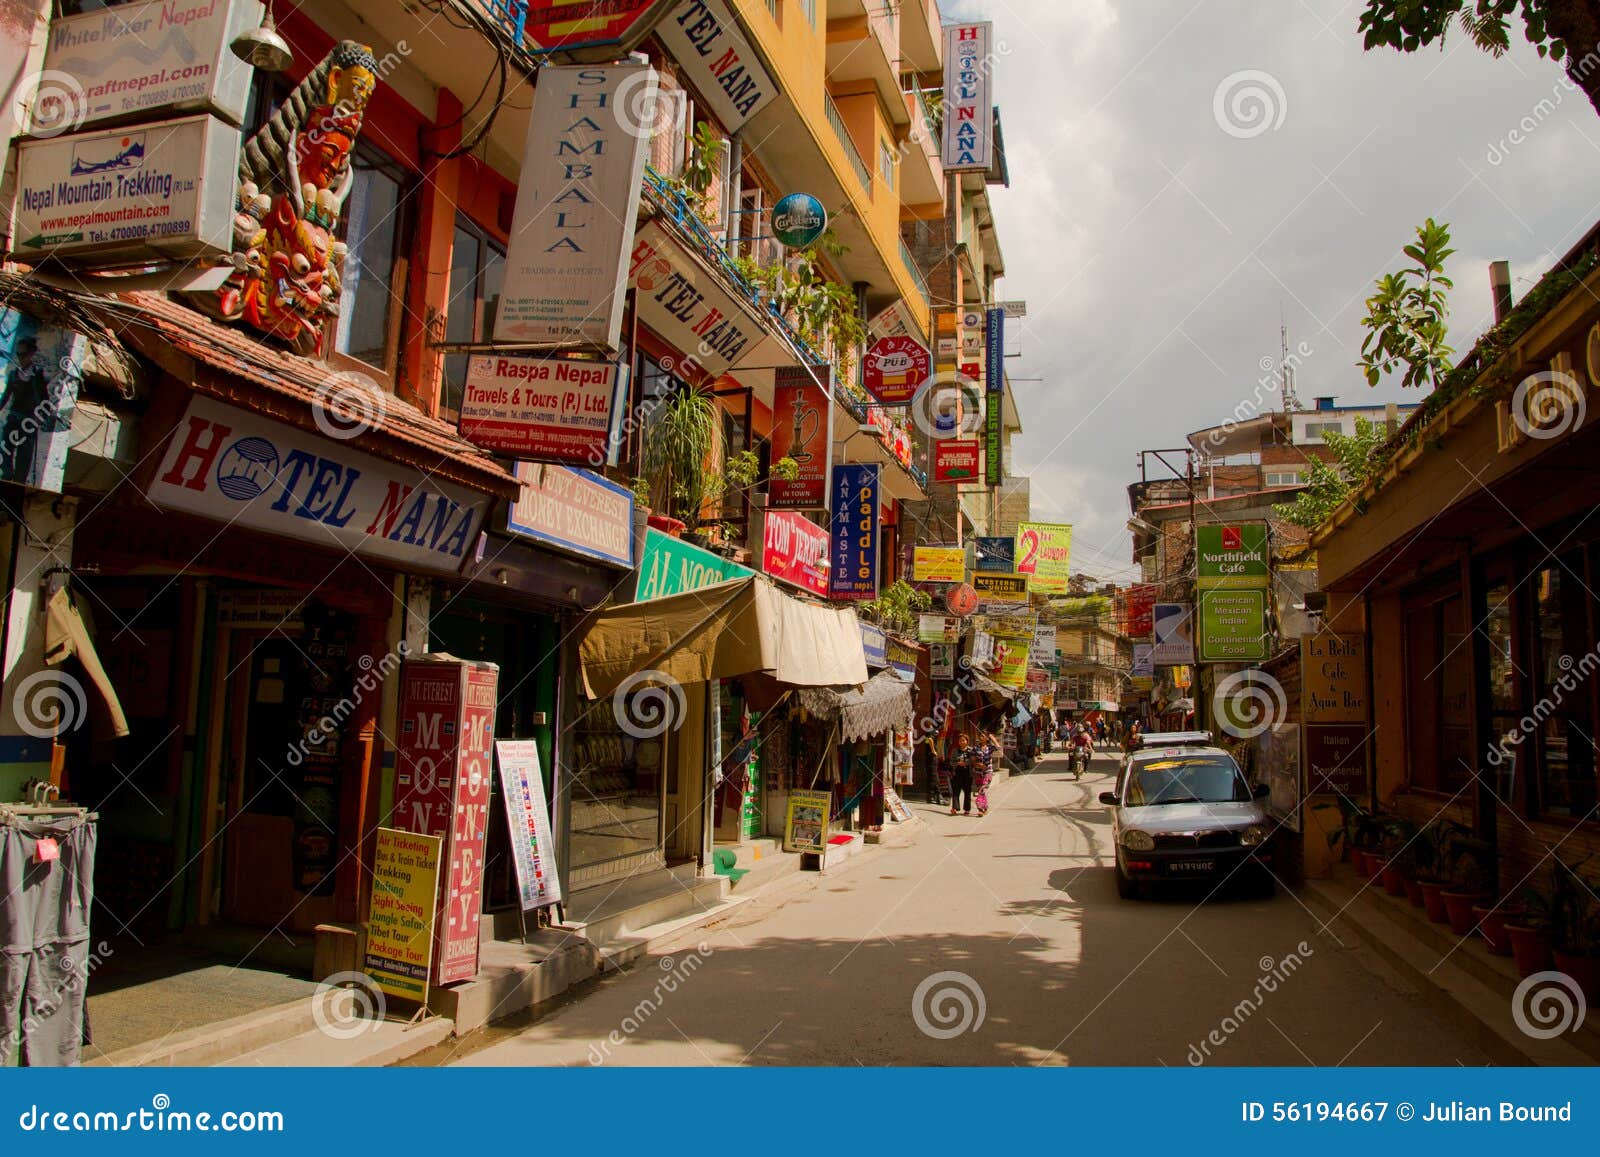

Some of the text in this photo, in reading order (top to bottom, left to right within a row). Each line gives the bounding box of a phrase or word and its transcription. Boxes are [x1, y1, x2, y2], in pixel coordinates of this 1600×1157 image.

[158, 1, 216, 30] Nepal
[708, 46, 763, 117] NANA
[956, 26, 979, 165] HOTEL NANA
[546, 69, 612, 253] SHAMBALA
[23, 187, 55, 216] Nepal
[57, 175, 113, 208] Mountain
[117, 170, 172, 201] Trekking
[40, 204, 170, 231] www.nepalmountain.com
[775, 213, 821, 232] Carlsberg
[629, 240, 748, 362] HOTEL NANA
[883, 357, 907, 367] PUB
[496, 360, 609, 387] Raspa Nepal
[467, 385, 508, 404] Travels
[512, 389, 520, 404] &
[525, 389, 558, 409] Tours
[584, 394, 608, 413] Ltd.
[534, 444, 558, 453] Floor
[938, 458, 976, 467] STREET
[161, 416, 474, 556] HOTEL NANA
[575, 482, 625, 522] EVEREST
[515, 488, 627, 554] MONEY EXCHANGE
[767, 513, 790, 556] TOM
[858, 487, 872, 580] paddle
[1017, 528, 1039, 575] 2
[1203, 551, 1261, 562] Northfield
[643, 548, 672, 599] AL
[1211, 597, 1255, 605] American
[1214, 607, 1252, 615] Mexican
[1218, 617, 1247, 625] Indian
[1207, 635, 1261, 644] Continental
[1222, 646, 1246, 654] Food
[1310, 639, 1322, 656] La
[423, 681, 454, 702] EVEREST
[1309, 691, 1362, 709] Aqua Bar
[1323, 735, 1350, 745] Italian
[1334, 751, 1340, 760] &
[412, 711, 443, 834] MON
[1312, 765, 1362, 776] Continental
[458, 714, 486, 933] MONEY
[379, 834, 429, 856] Air Ticketing
[376, 849, 436, 870] Bus & Train Ticket
[376, 864, 411, 883] Trekking
[374, 880, 404, 897] Rafting
[373, 894, 394, 910] Sight
[371, 910, 425, 931] Jungle Safari
[370, 924, 410, 943] Tibet Tour
[368, 941, 424, 961] Package Tour
